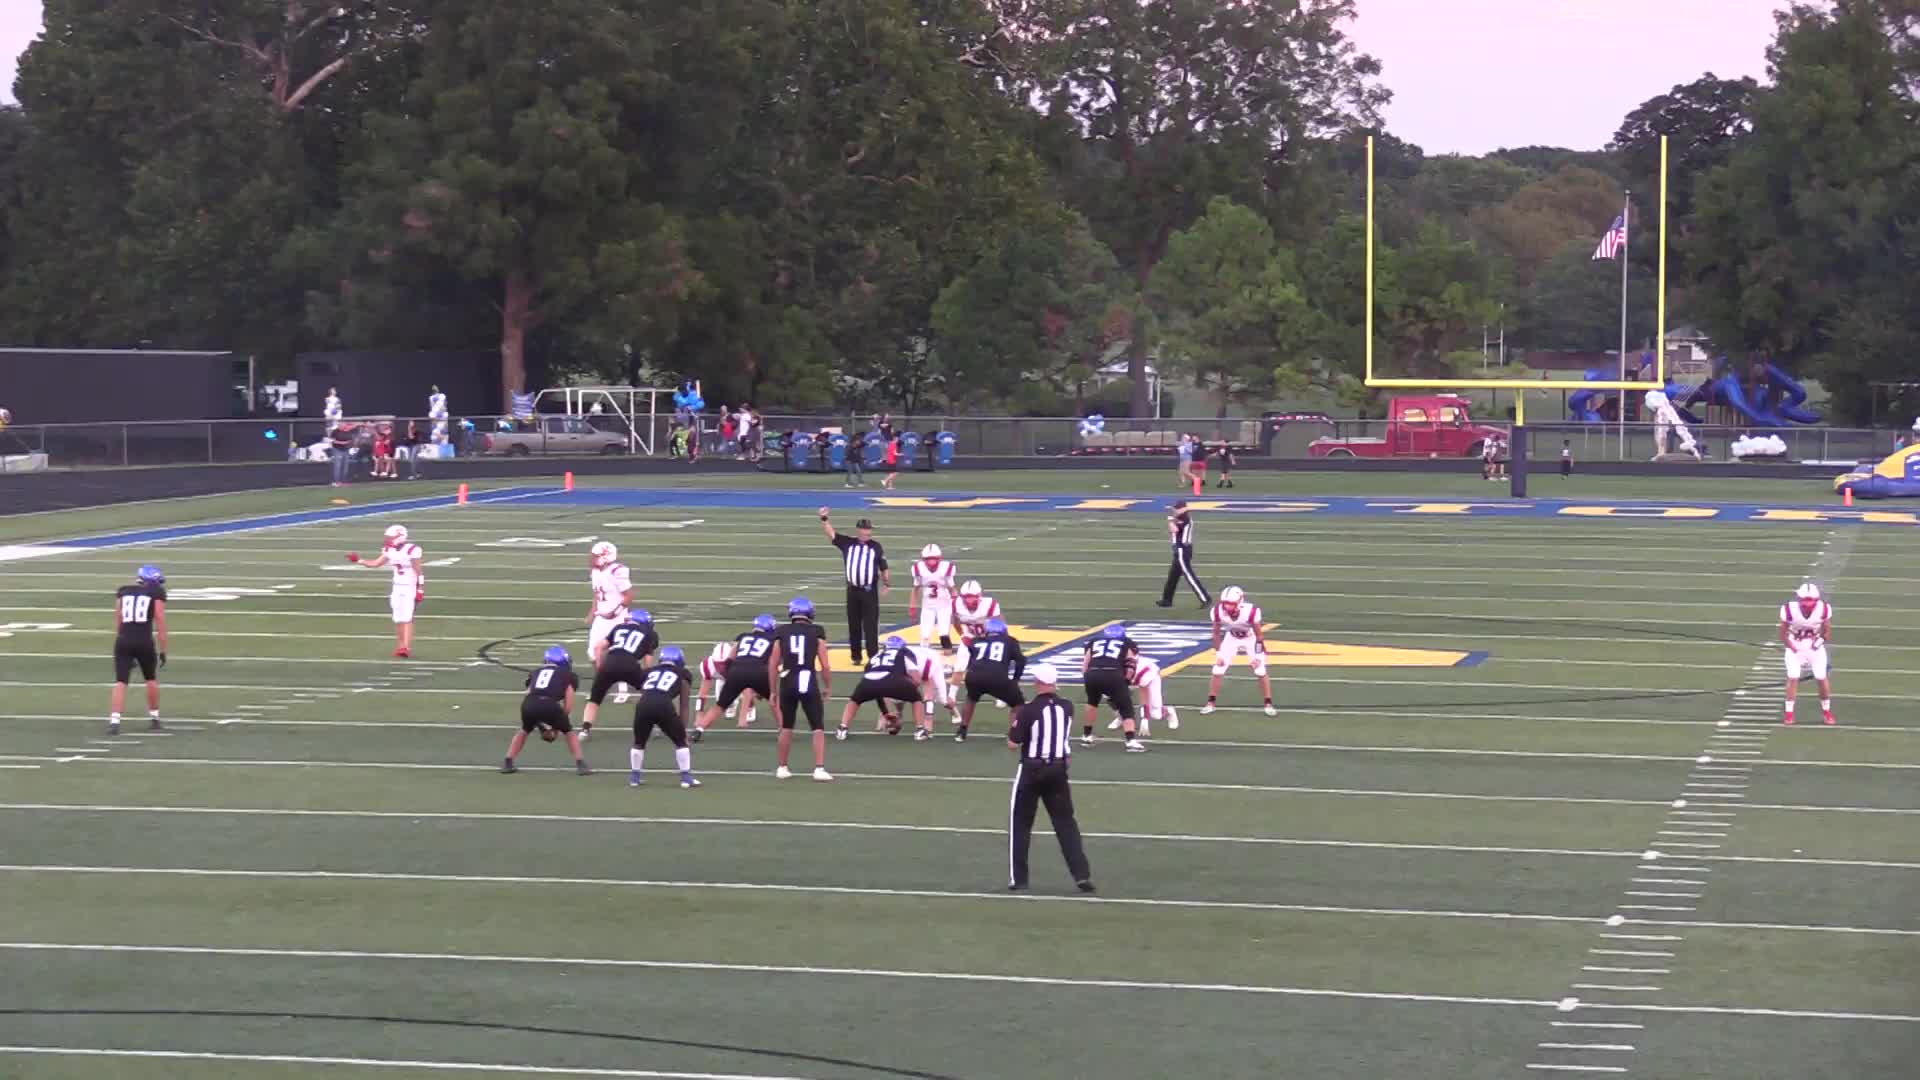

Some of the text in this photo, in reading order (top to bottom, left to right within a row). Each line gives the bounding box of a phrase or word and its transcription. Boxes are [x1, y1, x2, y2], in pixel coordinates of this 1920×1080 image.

[929, 583, 940, 600] 3
[120, 595, 152, 623] 88
[611, 629, 645, 653] 50
[737, 636, 771, 658] 59
[789, 634, 806, 666] 4
[973, 641, 1005, 662] 78
[1091, 638, 1124, 660] 55
[534, 668, 555, 689] 8
[642, 670, 678, 692] 28
